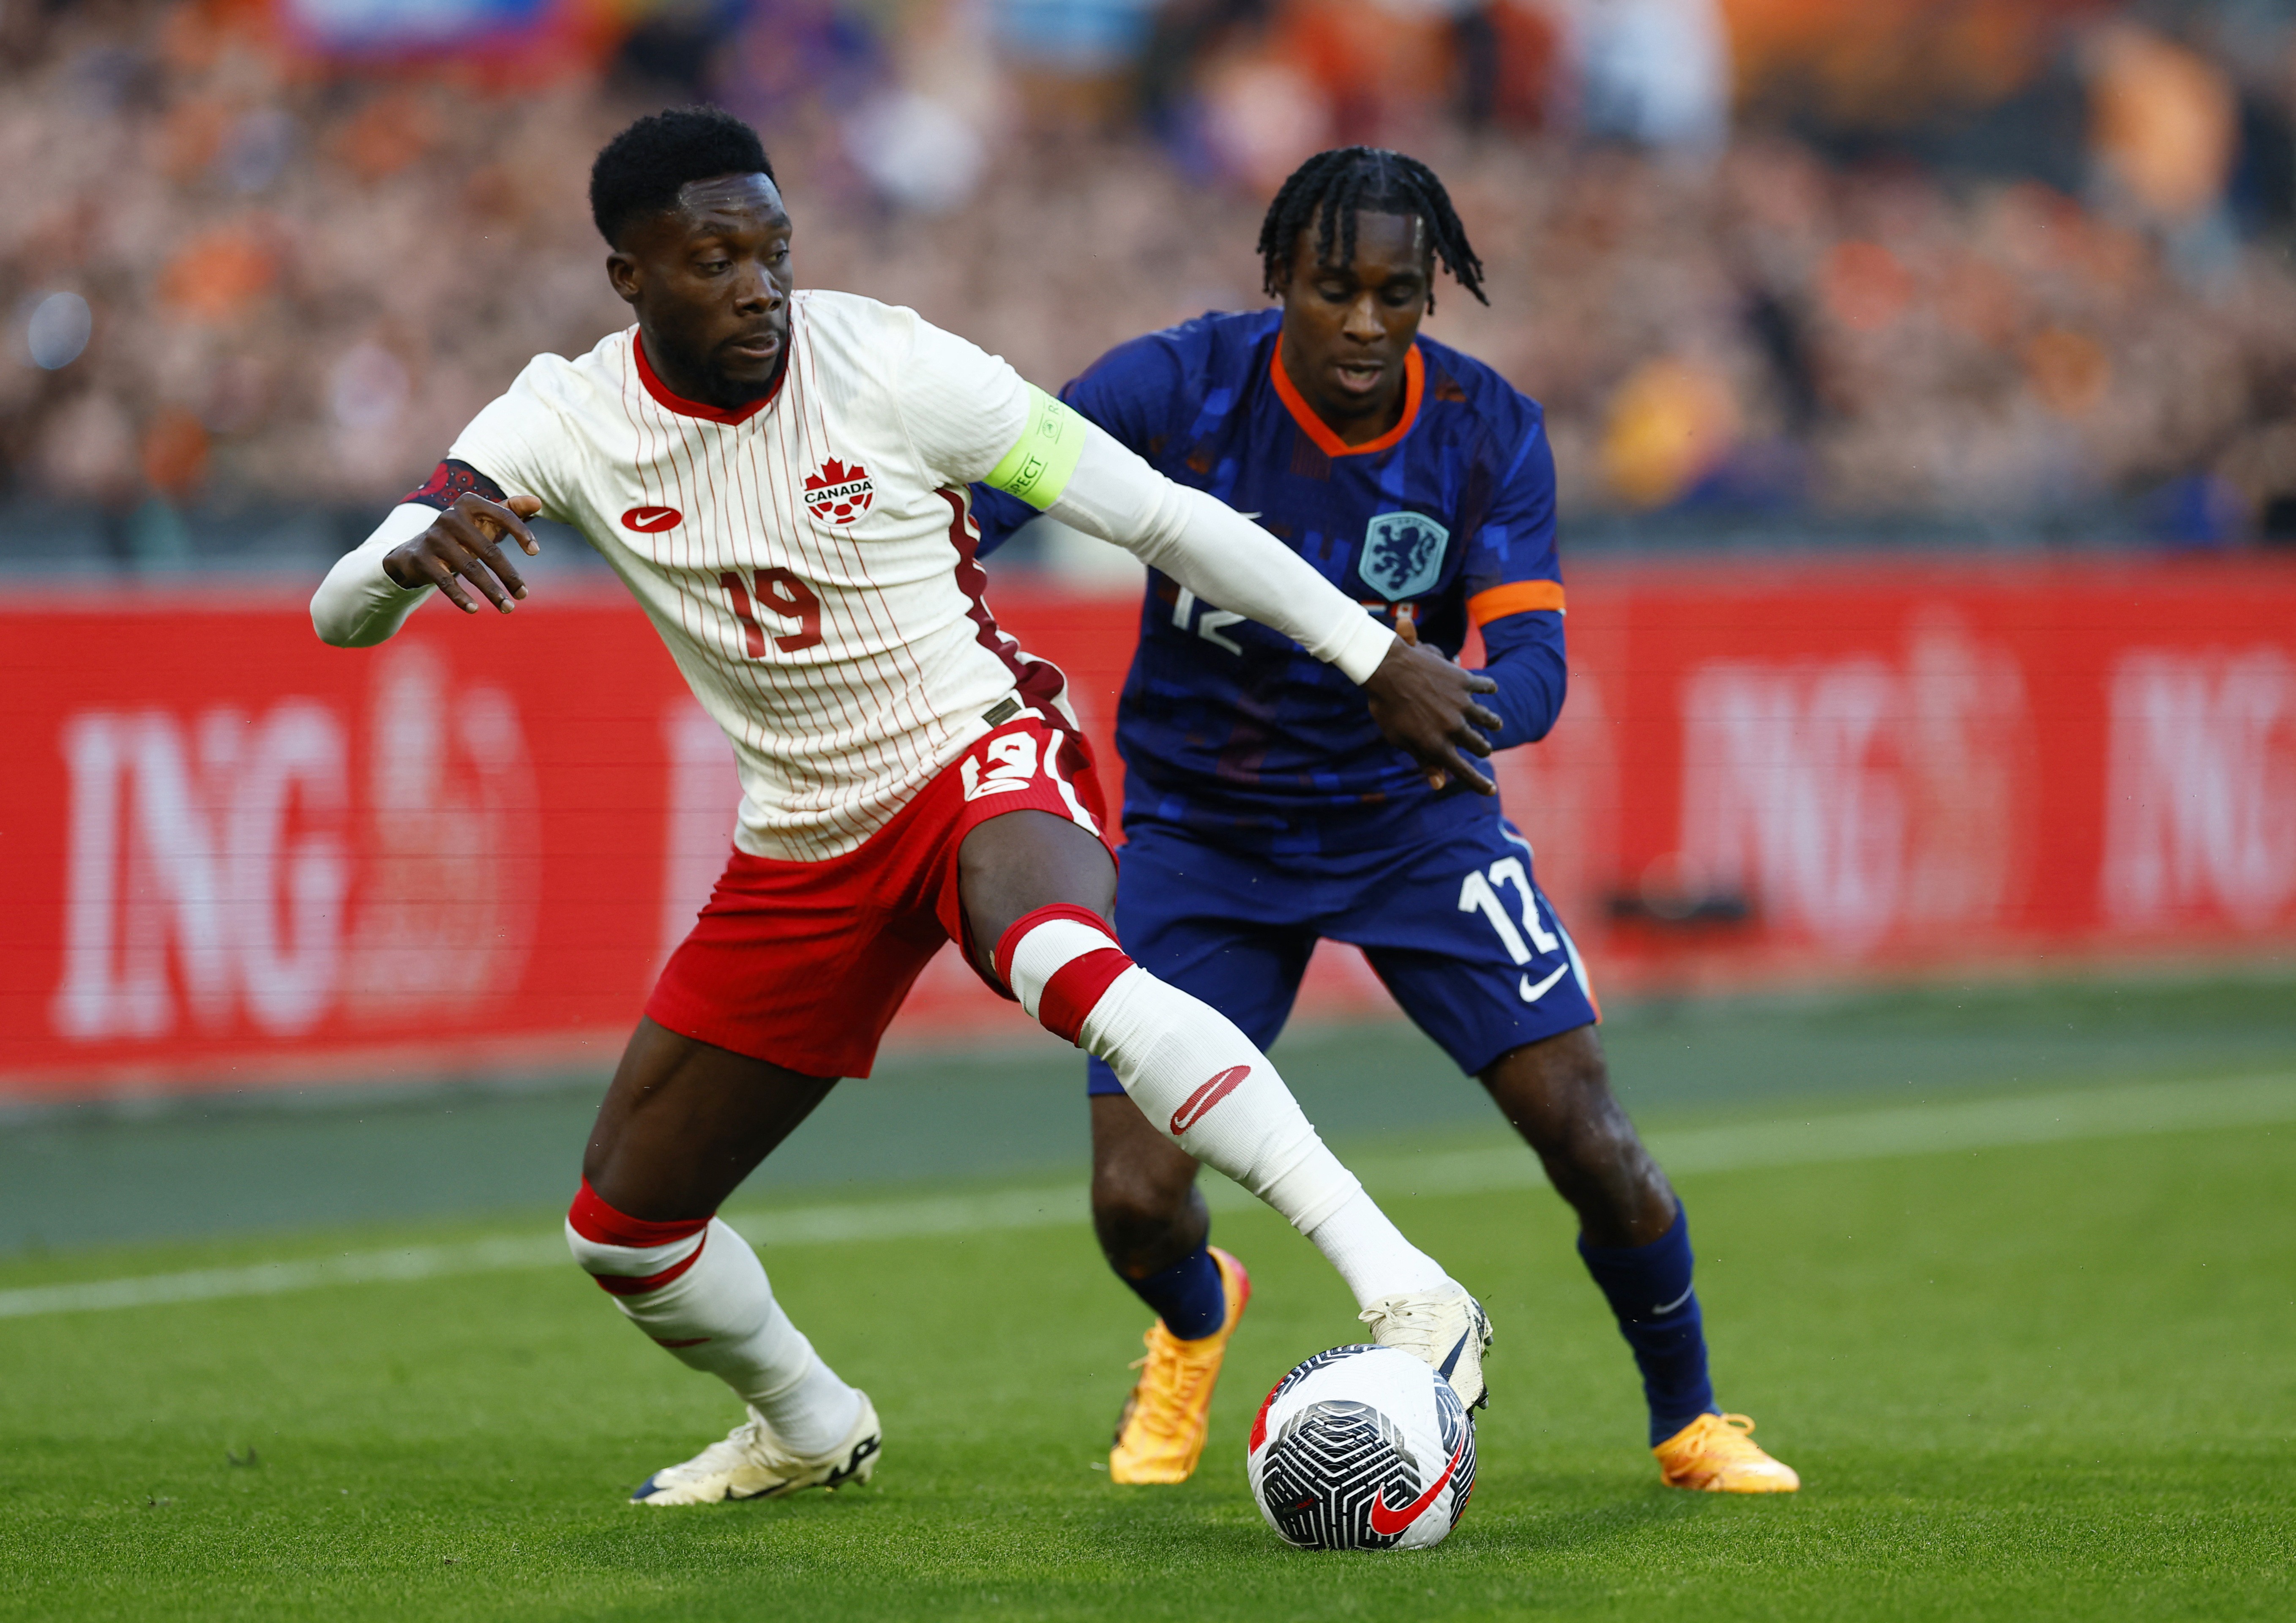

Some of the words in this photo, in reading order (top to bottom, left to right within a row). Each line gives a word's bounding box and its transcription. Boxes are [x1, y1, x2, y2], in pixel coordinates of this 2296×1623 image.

[804, 481, 873, 503] CANADA
[720, 567, 822, 658] 19
[960, 730, 1039, 802] 19
[55, 702, 349, 1040] ING
[1457, 856, 1560, 966] 12
